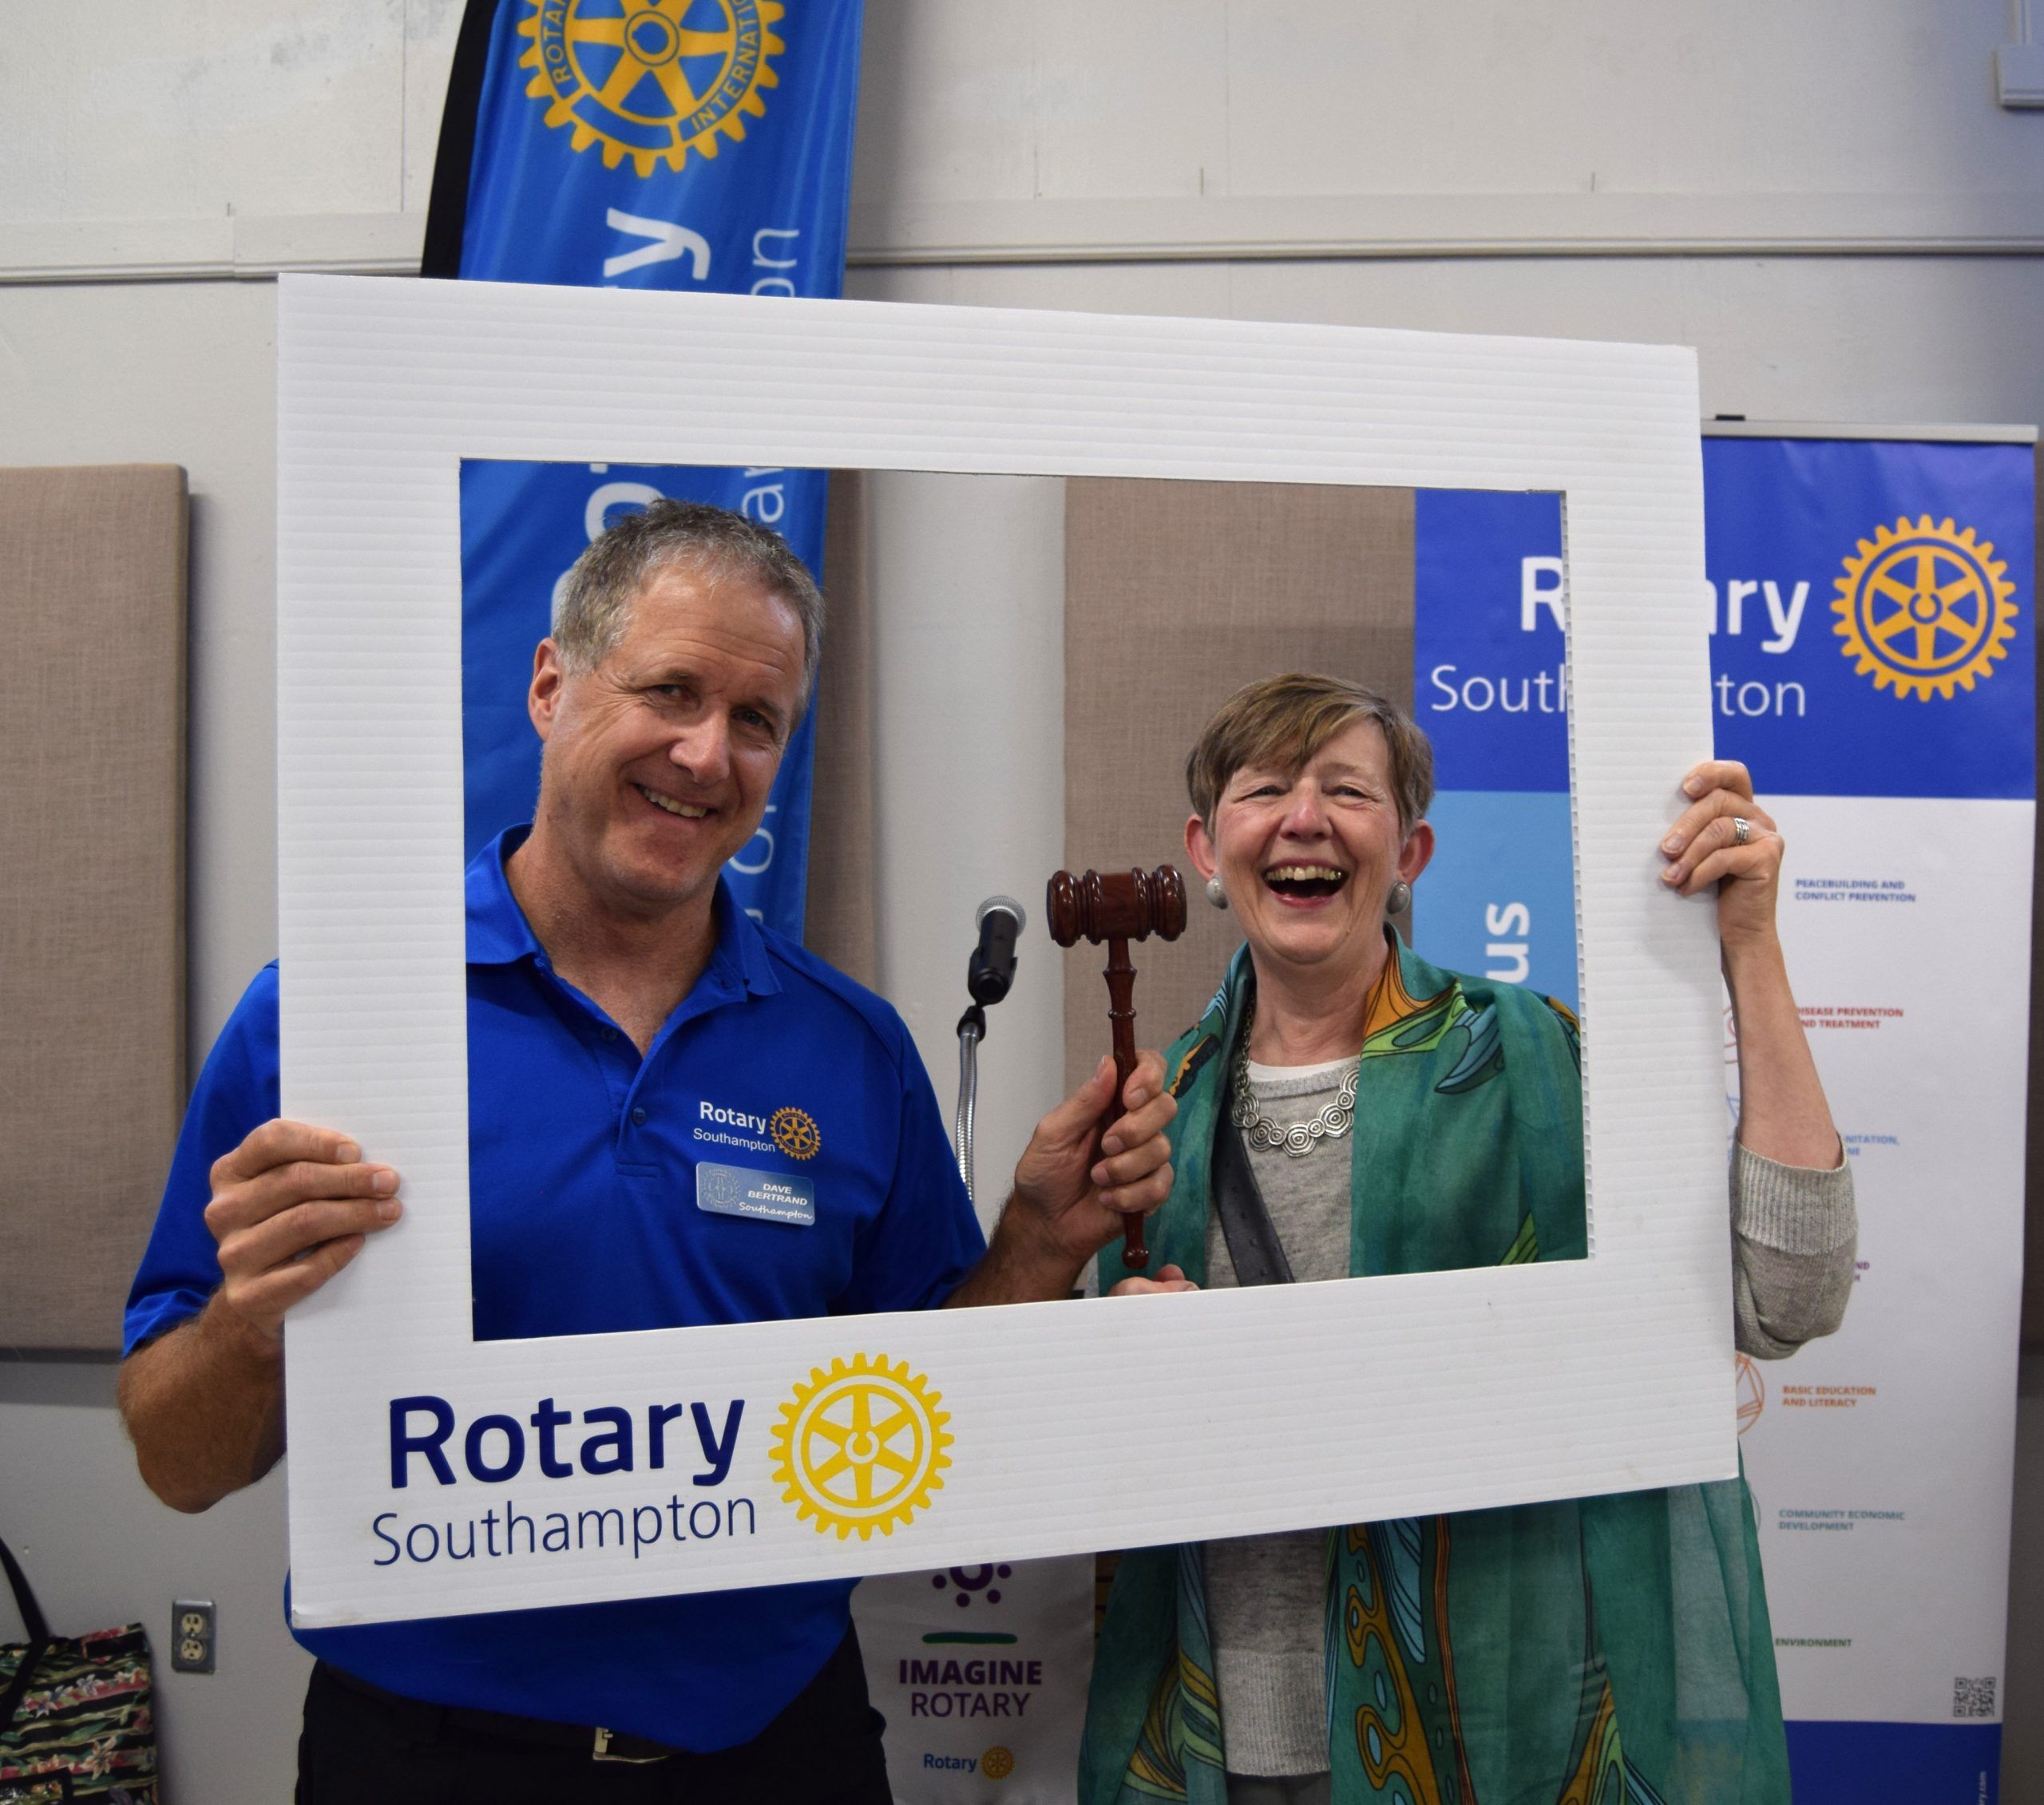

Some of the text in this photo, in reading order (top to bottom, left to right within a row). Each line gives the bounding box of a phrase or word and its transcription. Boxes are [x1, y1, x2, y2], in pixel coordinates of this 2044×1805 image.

[1795, 879, 1905, 890] PEACEBUILDING AND
[1795, 892, 1916, 902] CONFLICT PREVENTION
[1837, 1007, 1903, 1017] PREVENTION
[1801, 1019, 1880, 1029] ND TREATMENT
[699, 1101, 766, 1134] Rotary
[693, 1127, 776, 1152] Southampton
[763, 1182, 792, 1194] DAVE
[747, 1190, 808, 1205] BERTRAND
[739, 1201, 813, 1220] Southampton
[1783, 1385, 1876, 1395] BASIC EDUCATION
[1783, 1398, 1857, 1407] AND LITERACY
[390, 1395, 747, 1490] Rotary
[1779, 1510, 1905, 1521] COMMUNITY ECONOMIC
[373, 1494, 756, 1566] Southampton
[1779, 1522, 1855, 1531] DEVELOPMENT
[1775, 1637, 1852, 1648] ENVIRONMENT
[899, 1659, 1043, 1686] IMAGINE
[911, 1692, 1032, 1717] ROTARY
[923, 1753, 977, 1773] Rotary
